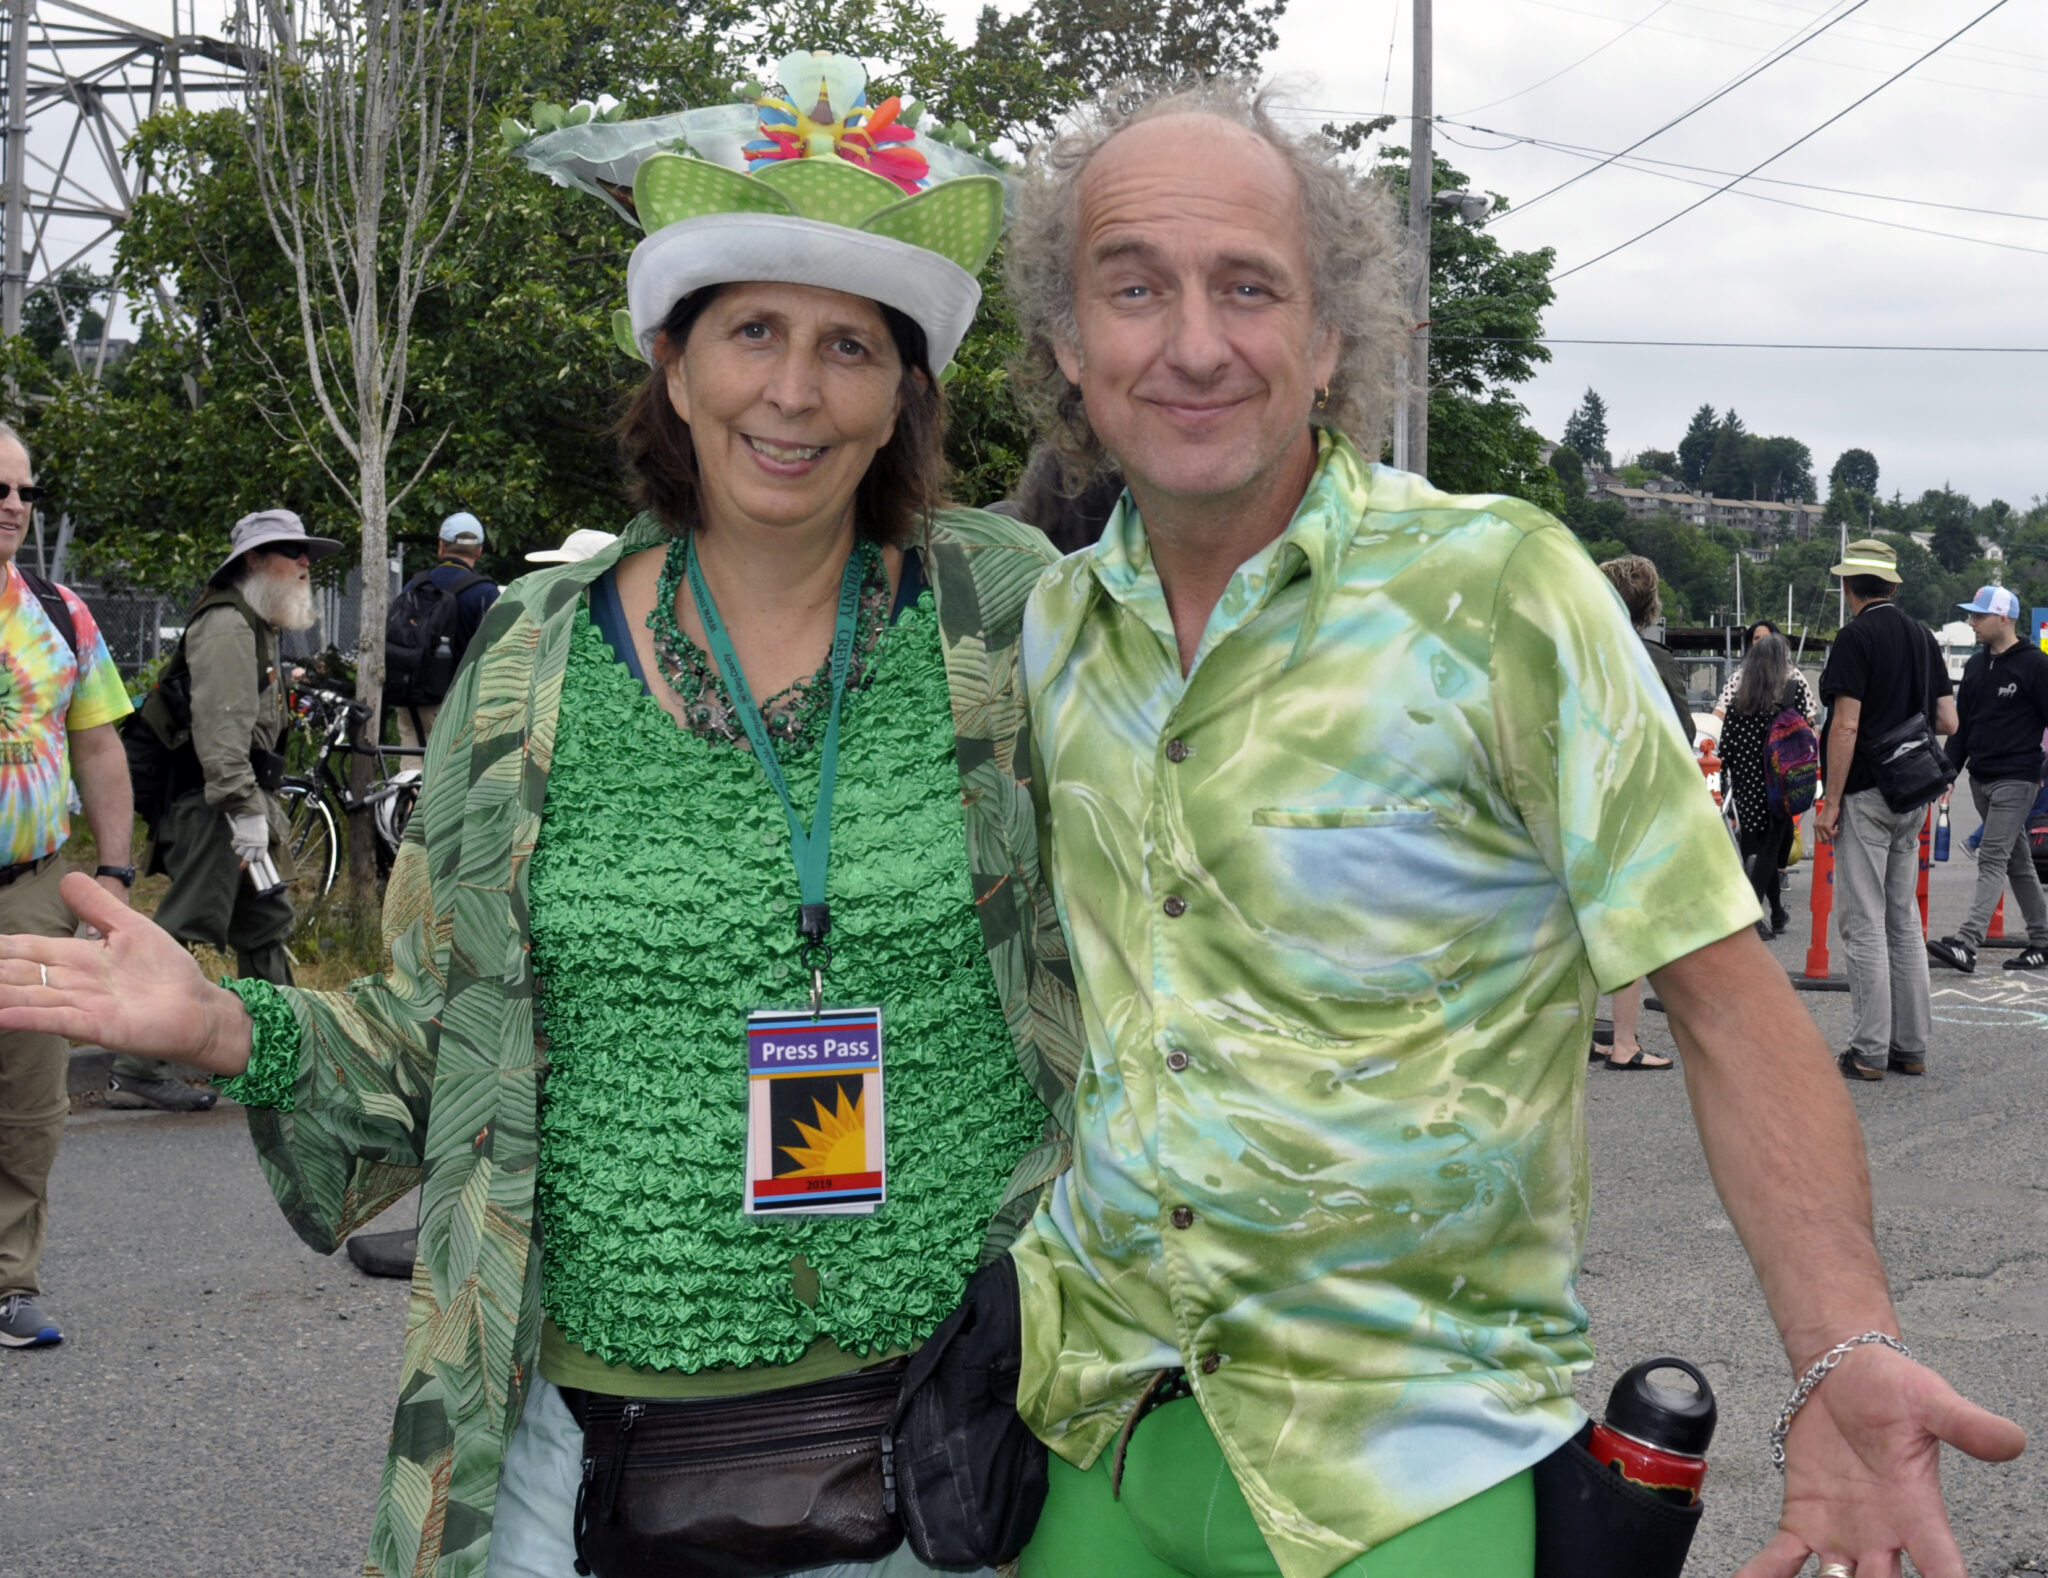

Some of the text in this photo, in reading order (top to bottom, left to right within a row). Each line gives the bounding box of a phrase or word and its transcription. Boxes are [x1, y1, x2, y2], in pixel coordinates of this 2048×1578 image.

[840, 559, 859, 620] COUNTY
[833, 629, 852, 680] CREDIT
[762, 1039, 870, 1062] Press Pass
[806, 1179, 833, 1190] 2019
